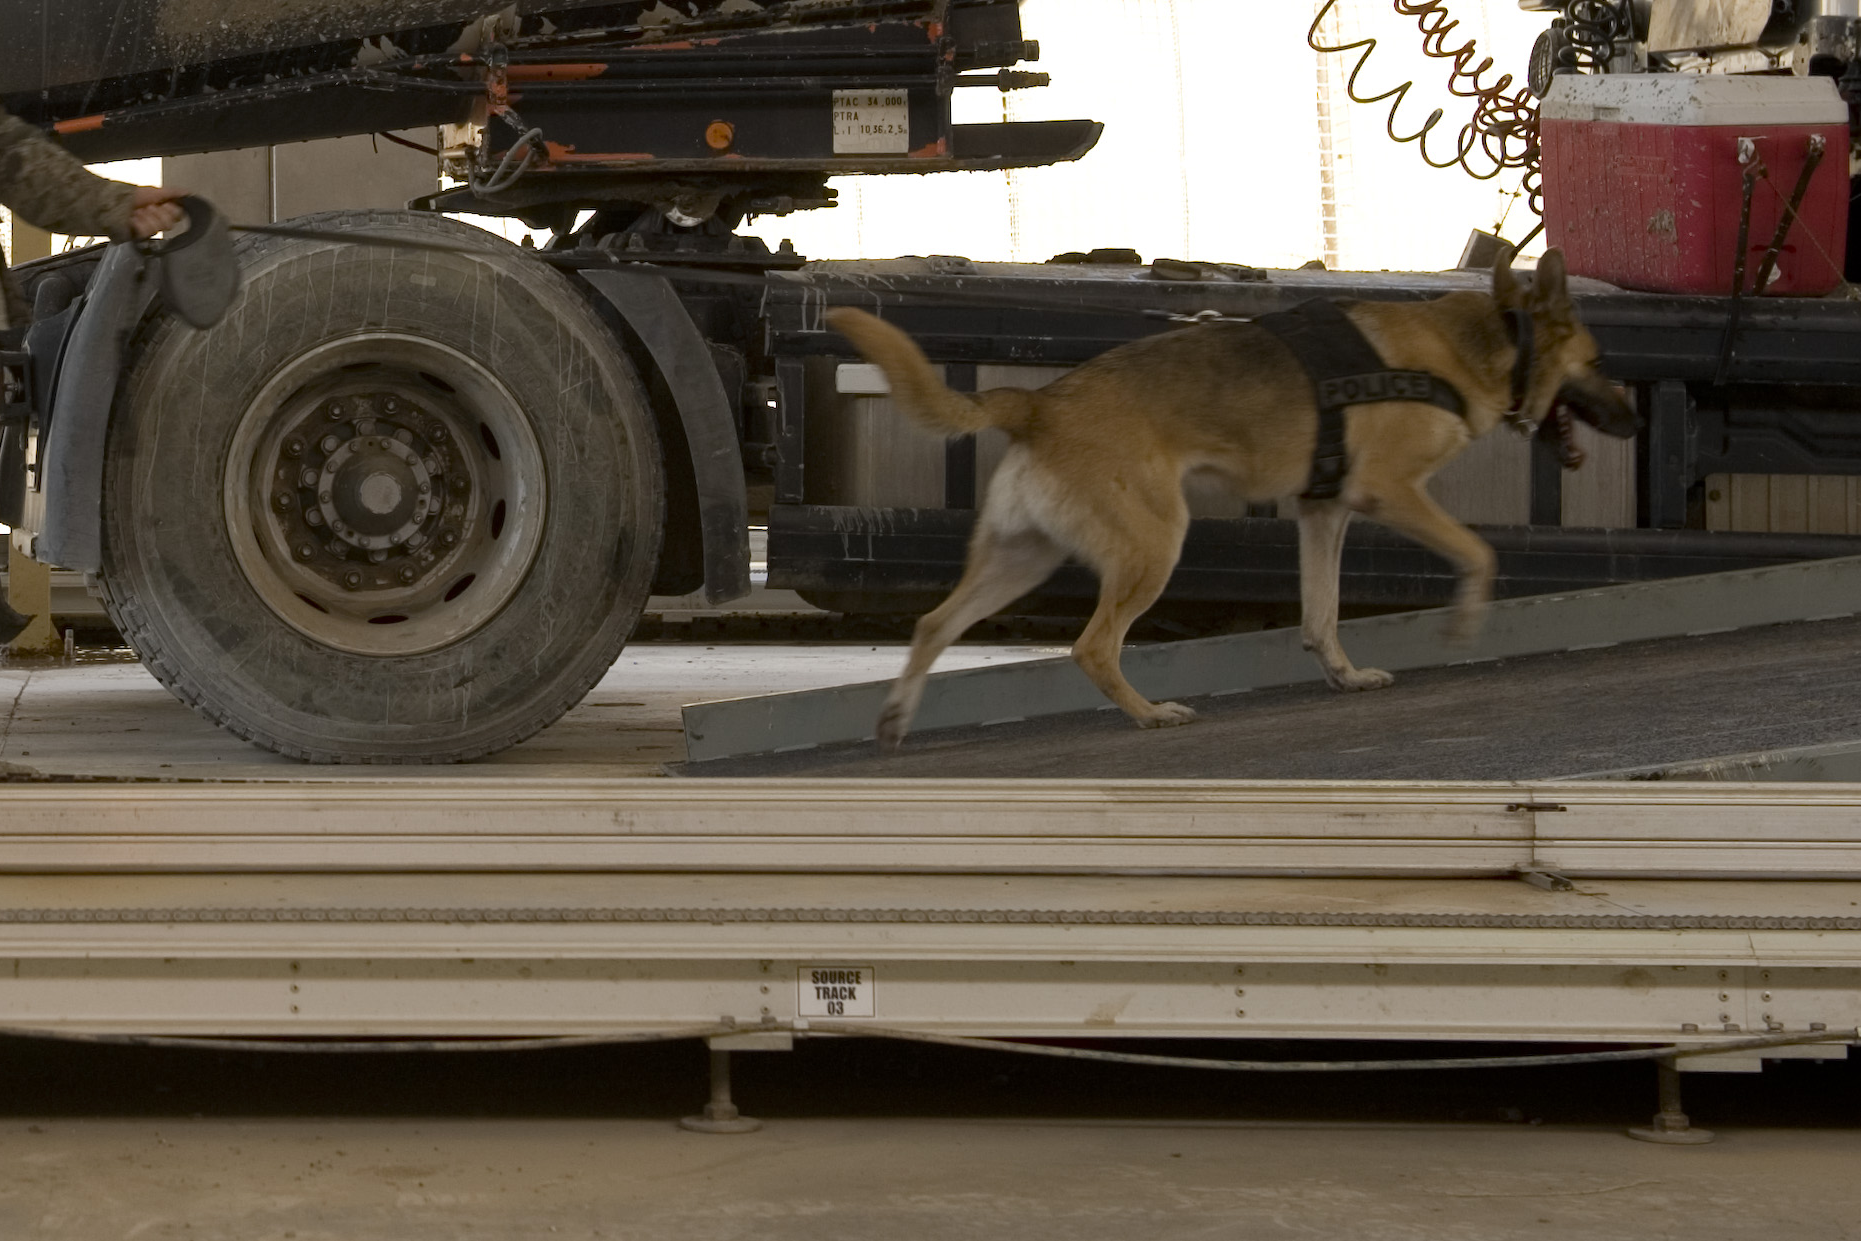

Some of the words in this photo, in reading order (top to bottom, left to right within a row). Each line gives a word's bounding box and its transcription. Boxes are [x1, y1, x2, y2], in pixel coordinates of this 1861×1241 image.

[833, 97, 859, 107] PTAC
[833, 111, 859, 121] PTRA
[1324, 373, 1427, 404] POLICE
[811, 969, 861, 984] SOURCE
[815, 986, 857, 1000] TRACK
[827, 1001, 844, 1015] 03
